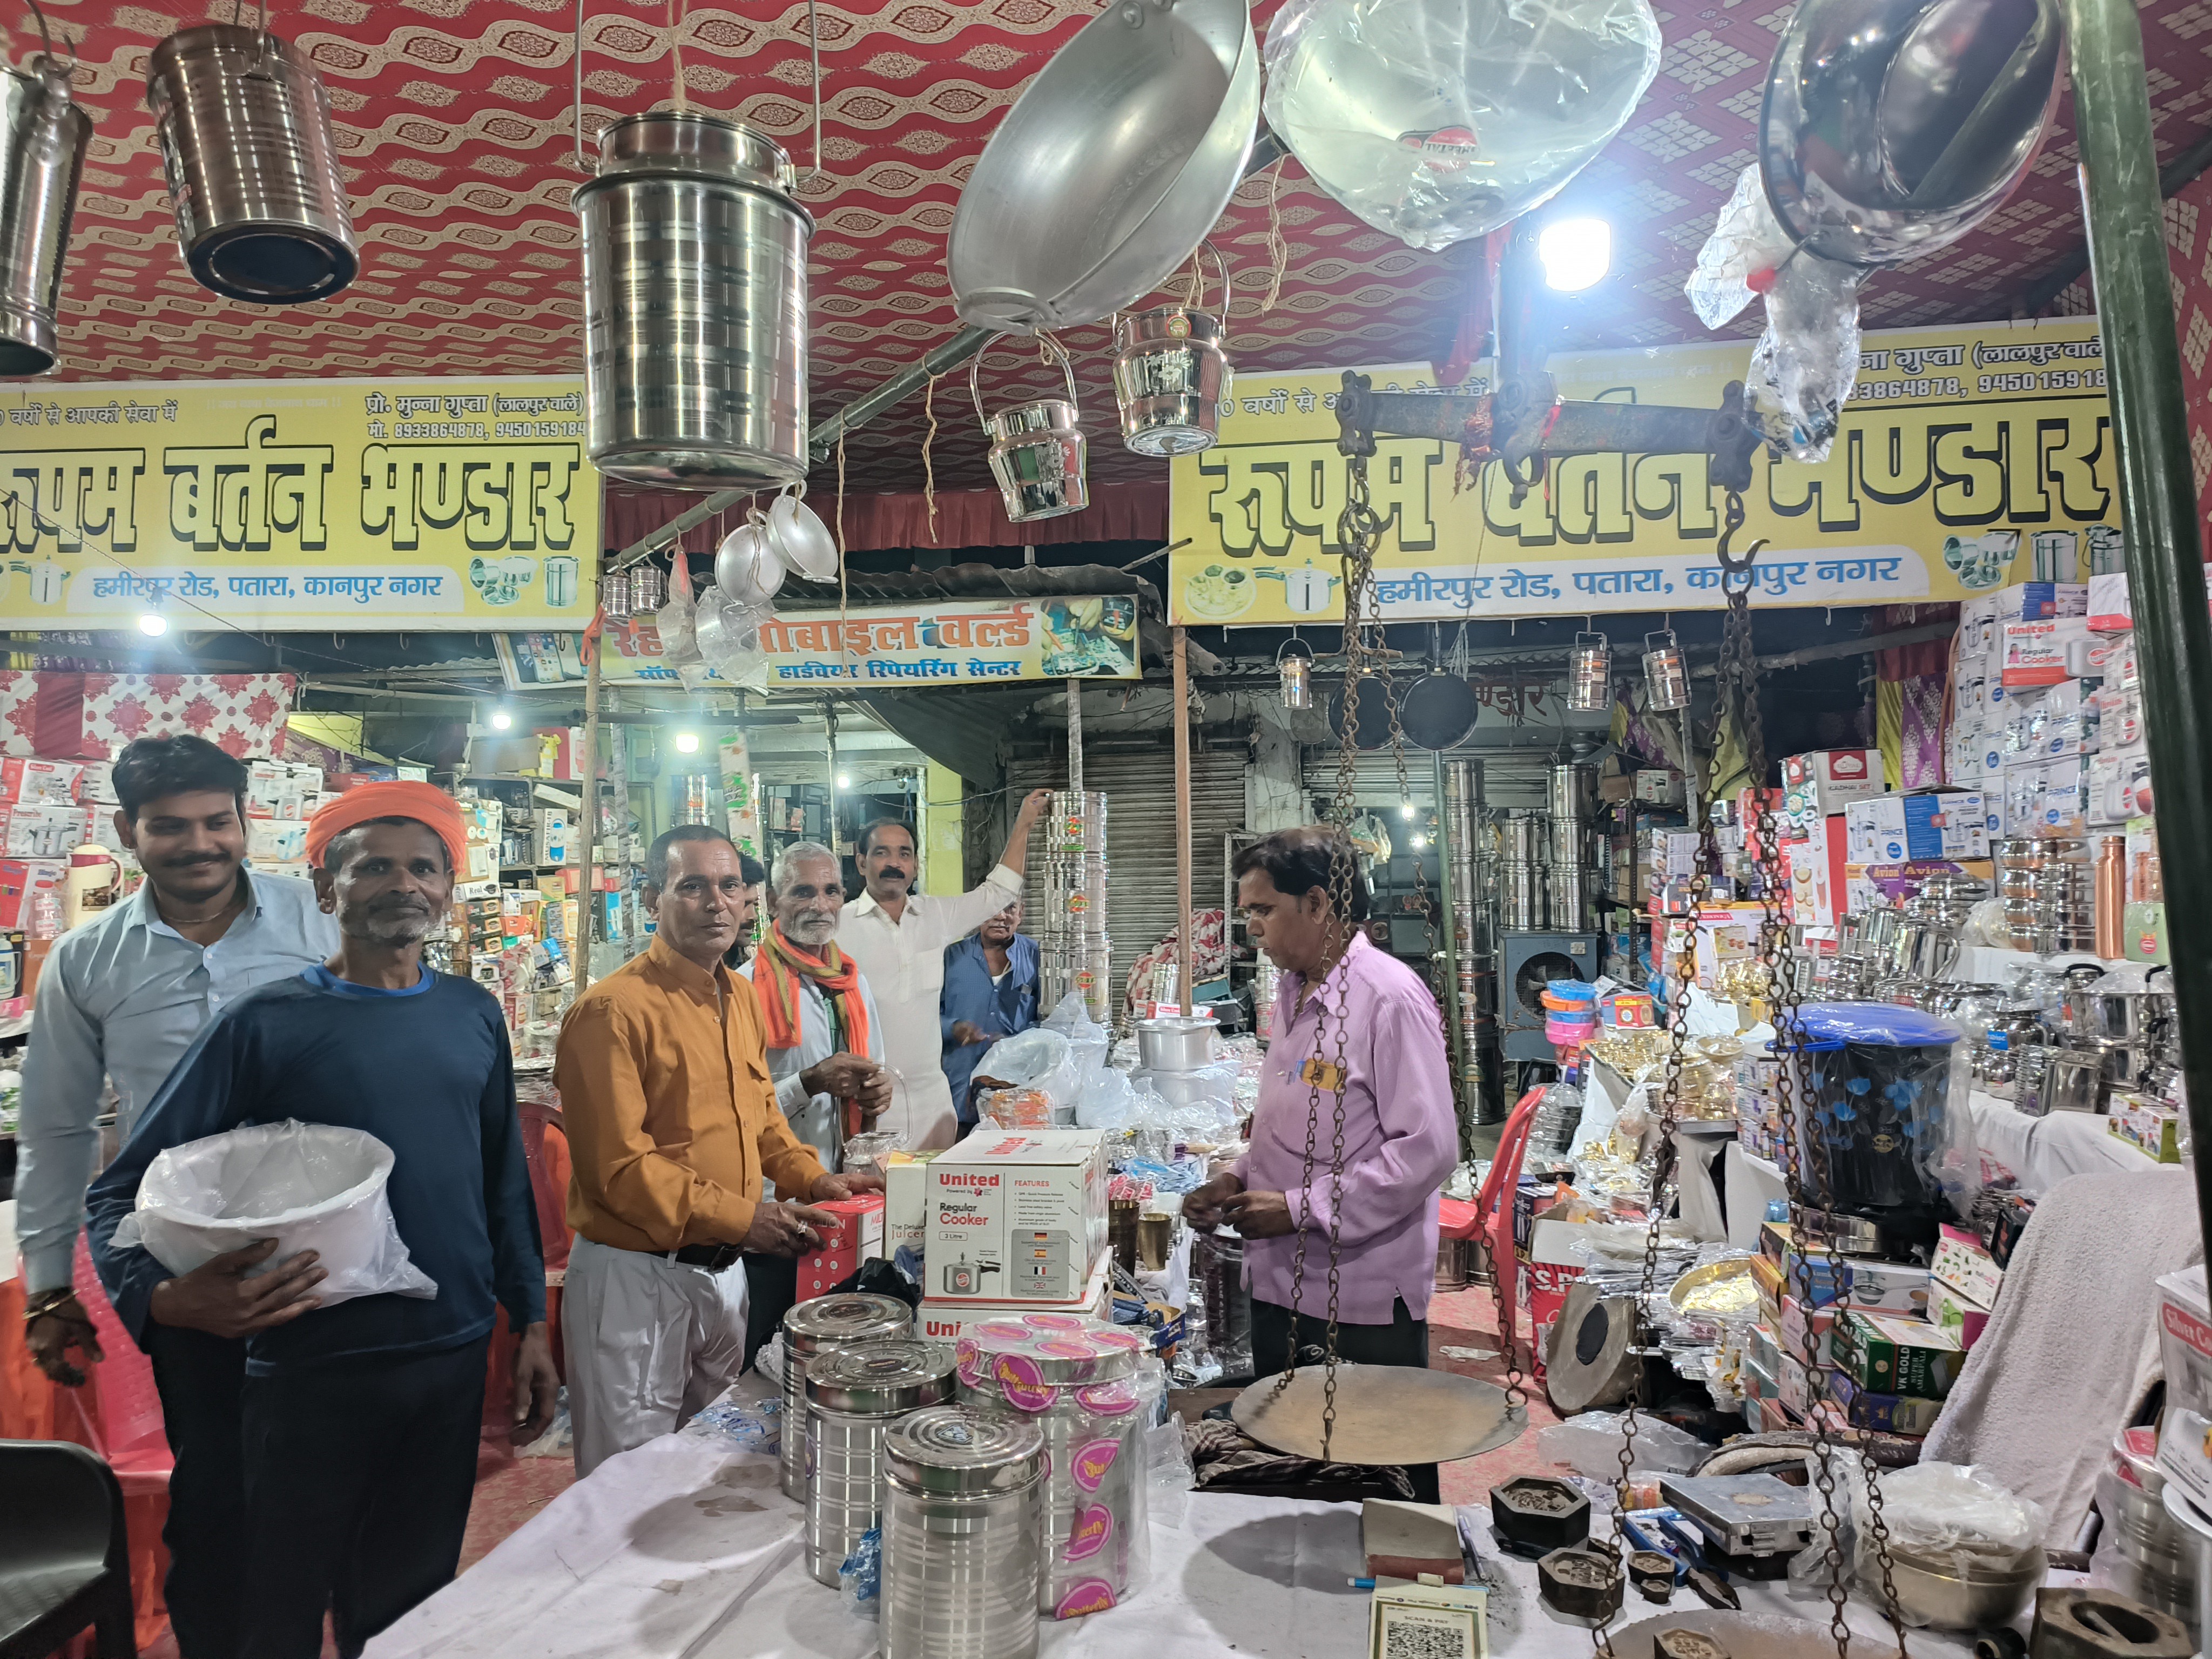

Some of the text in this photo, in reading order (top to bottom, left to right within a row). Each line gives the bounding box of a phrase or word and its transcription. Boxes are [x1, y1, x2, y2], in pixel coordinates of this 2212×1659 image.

[1893, 345, 1965, 375] गुप्ता
[1846, 369, 2107, 401] 33864878, 945015918
[395, 395, 442, 419] मुन्ना
[443, 395, 488, 419] गुप्ता
[1293, 387, 1316, 414] से
[45, 402, 60, 425] से
[65, 400, 121, 424] आपकी
[124, 400, 159, 423] सेवा
[163, 399, 178, 422] में
[367, 420, 388, 439] मो.
[163, 414, 334, 552] बर्तन
[361, 442, 579, 551] भण्डार
[179, 571, 219, 599] रोड,
[228, 576, 296, 599] पतारा,
[304, 576, 385, 604] कानपुर
[388, 576, 443, 596] नगर
[1376, 571, 1494, 610] हमीरपुर
[1500, 569, 1561, 600] रोड,
[1572, 568, 1674, 595] पतारा,
[1815, 557, 1904, 584] नगर
[2007, 624, 2055, 635] United
[2021, 655, 2065, 664] Cooker
[1873, 867, 1899, 878] Avion
[1904, 866, 1951, 875] Avion
[939, 1173, 1000, 1186] United
[940, 1202, 978, 1214] Regular
[871, 1212, 884, 1226] MILT
[940, 1212, 989, 1225] Cooker
[891, 1230, 925, 1240] Juicer
[926, 1321, 961, 1337] Uni
[1899, 1347, 1910, 1374] GOLD
[1897, 1377, 1907, 1390] VK
